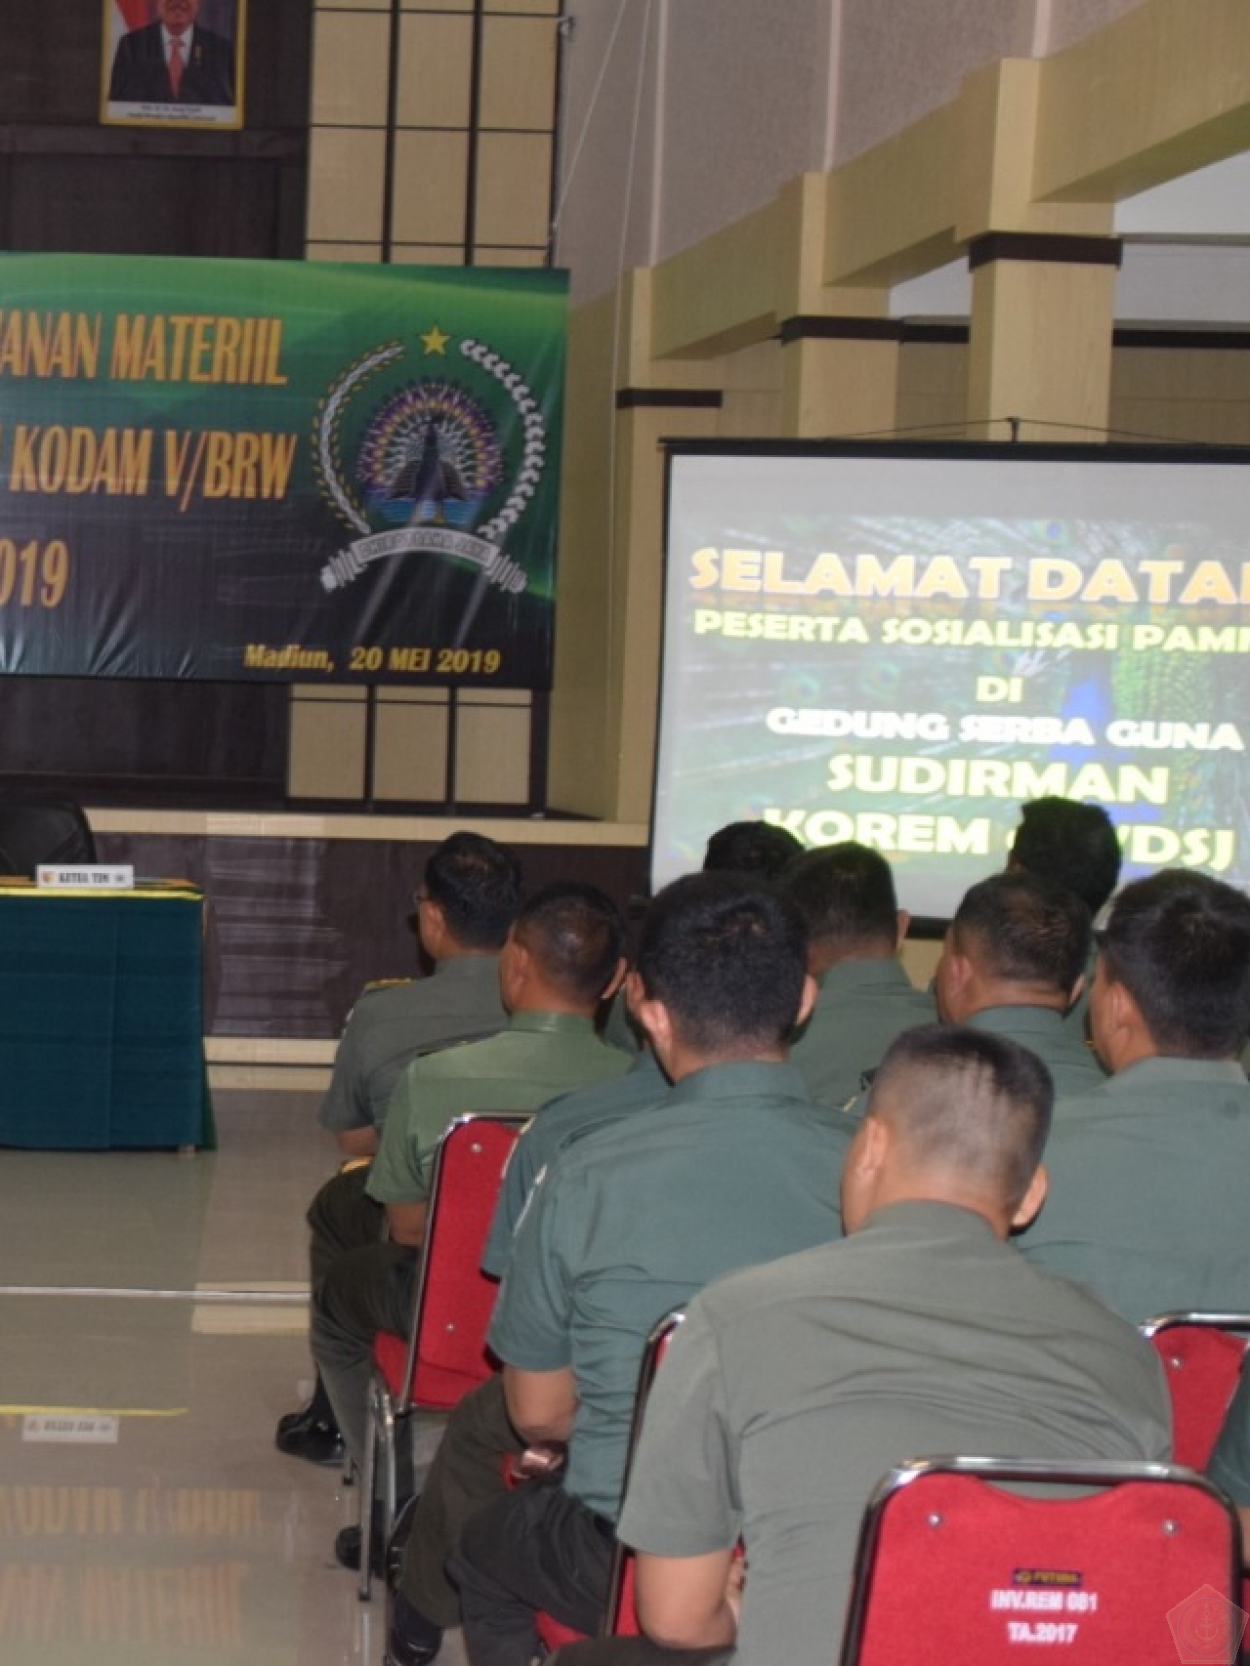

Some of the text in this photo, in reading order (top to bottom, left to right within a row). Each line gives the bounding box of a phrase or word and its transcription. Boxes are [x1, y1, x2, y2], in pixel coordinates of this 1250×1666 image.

[110, 312, 288, 386] MATERIIL
[9, 424, 153, 496] KODAM
[164, 428, 297, 513] V/BRW
[688, 547, 1250, 605] SELAMAT DATA
[693, 608, 870, 644] PESERTA
[881, 617, 1118, 652] SOSIALISASI
[349, 645, 383, 671] 20
[388, 647, 432, 672] MEI
[435, 649, 501, 673] 2019
[976, 675, 1024, 703] DI
[766, 707, 1245, 751] GEDUNG SERBA GUNA
[827, 753, 1170, 804] SUDIRMAN
[1007, 1621, 1079, 1644] TA.2017
